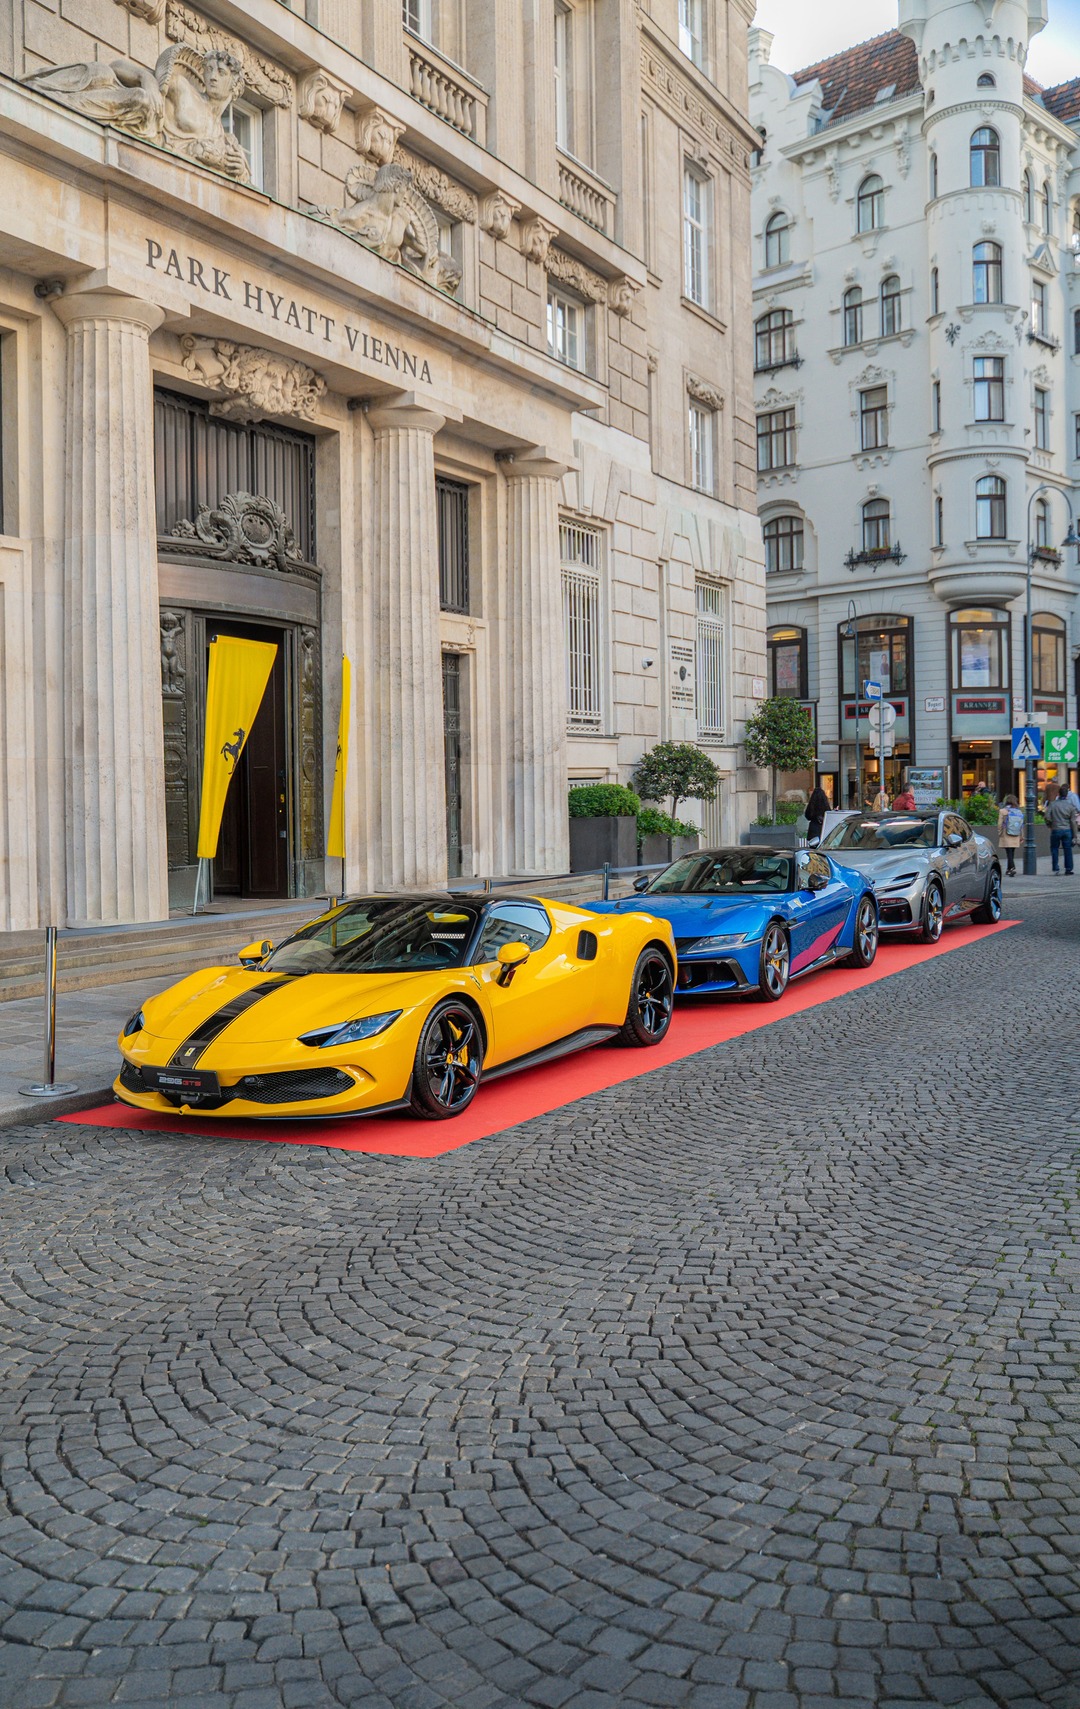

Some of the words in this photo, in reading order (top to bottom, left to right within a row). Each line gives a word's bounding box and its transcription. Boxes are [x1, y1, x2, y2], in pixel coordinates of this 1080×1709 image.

[145, 238, 233, 301] PARK
[242, 280, 335, 343] HYATT
[344, 324, 433, 385] VIENNA
